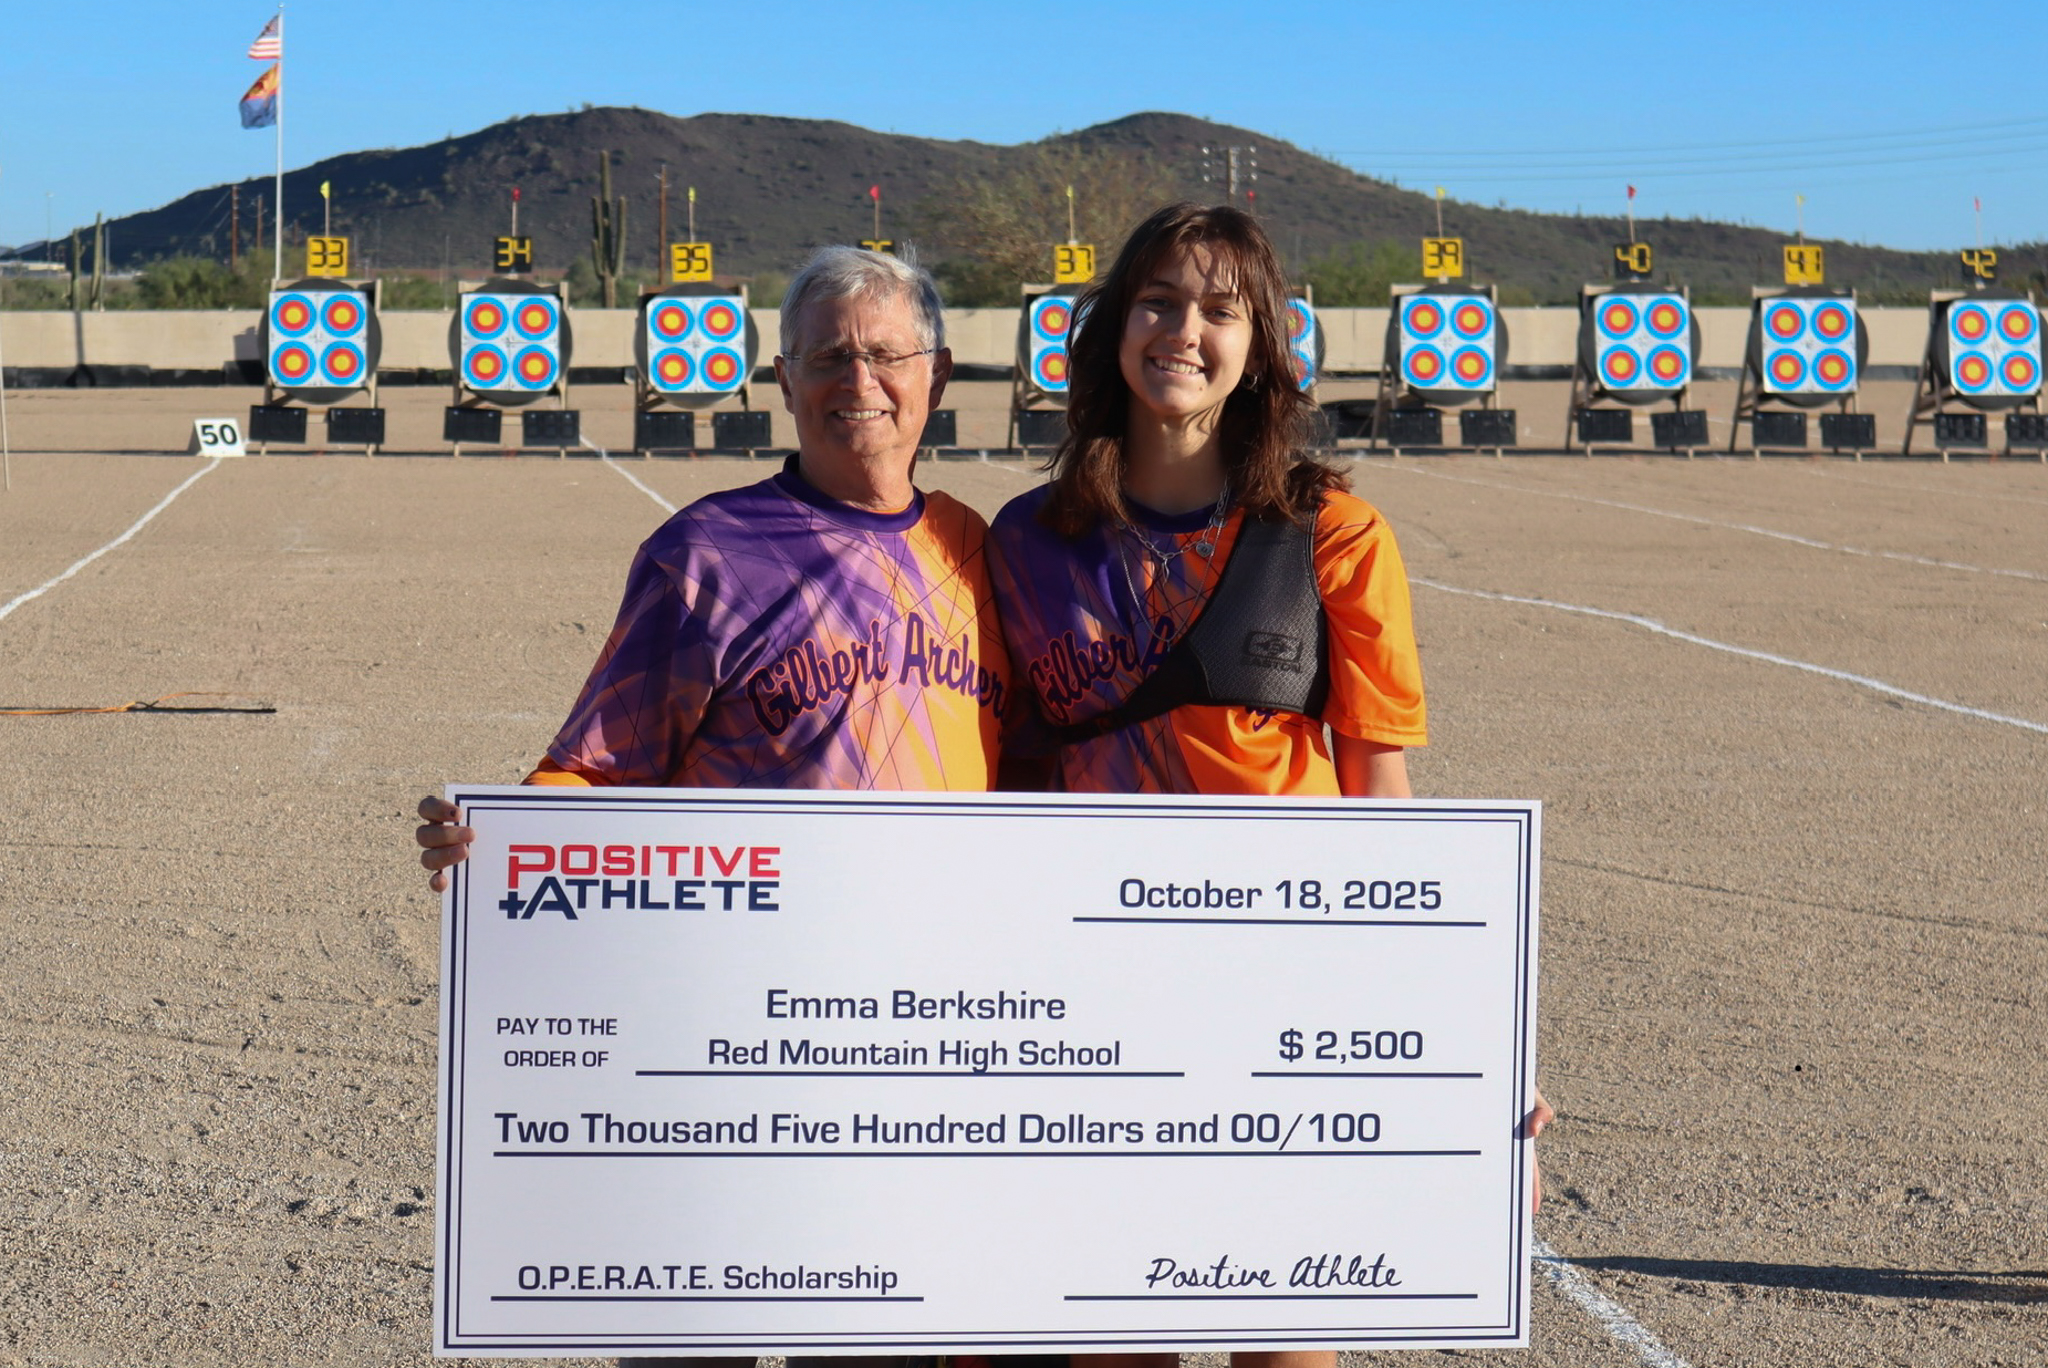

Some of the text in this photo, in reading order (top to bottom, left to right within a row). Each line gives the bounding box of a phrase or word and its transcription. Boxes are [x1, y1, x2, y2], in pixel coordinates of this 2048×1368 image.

[311, 238, 344, 268] 33
[498, 237, 531, 267] 34
[675, 245, 708, 273] 35
[1059, 247, 1092, 275] 37
[1427, 240, 1459, 269] 39
[1615, 243, 1652, 273] 40
[1787, 249, 1821, 273] 41
[1961, 249, 1997, 278] 42
[200, 423, 238, 446] 50
[747, 618, 890, 737] Gilbert
[899, 611, 1007, 732] Archer
[507, 843, 781, 890] POSITIVE
[1119, 878, 1442, 915] October 18, 2025
[766, 989, 1067, 1020] Emma Berkshire
[496, 1017, 618, 1036] PAY TO THE
[503, 1049, 610, 1068] ORDER OF
[708, 1038, 1120, 1073] Red Mountain High School
[1278, 1027, 1423, 1065] $ 2,500
[493, 1112, 1381, 1151] Two Thousand Five Hundred Dollars and 00/100
[518, 1264, 898, 1296] O.P.E.R.A.T.E. Scholarship
[1145, 1252, 1404, 1290] Positive Athlete
